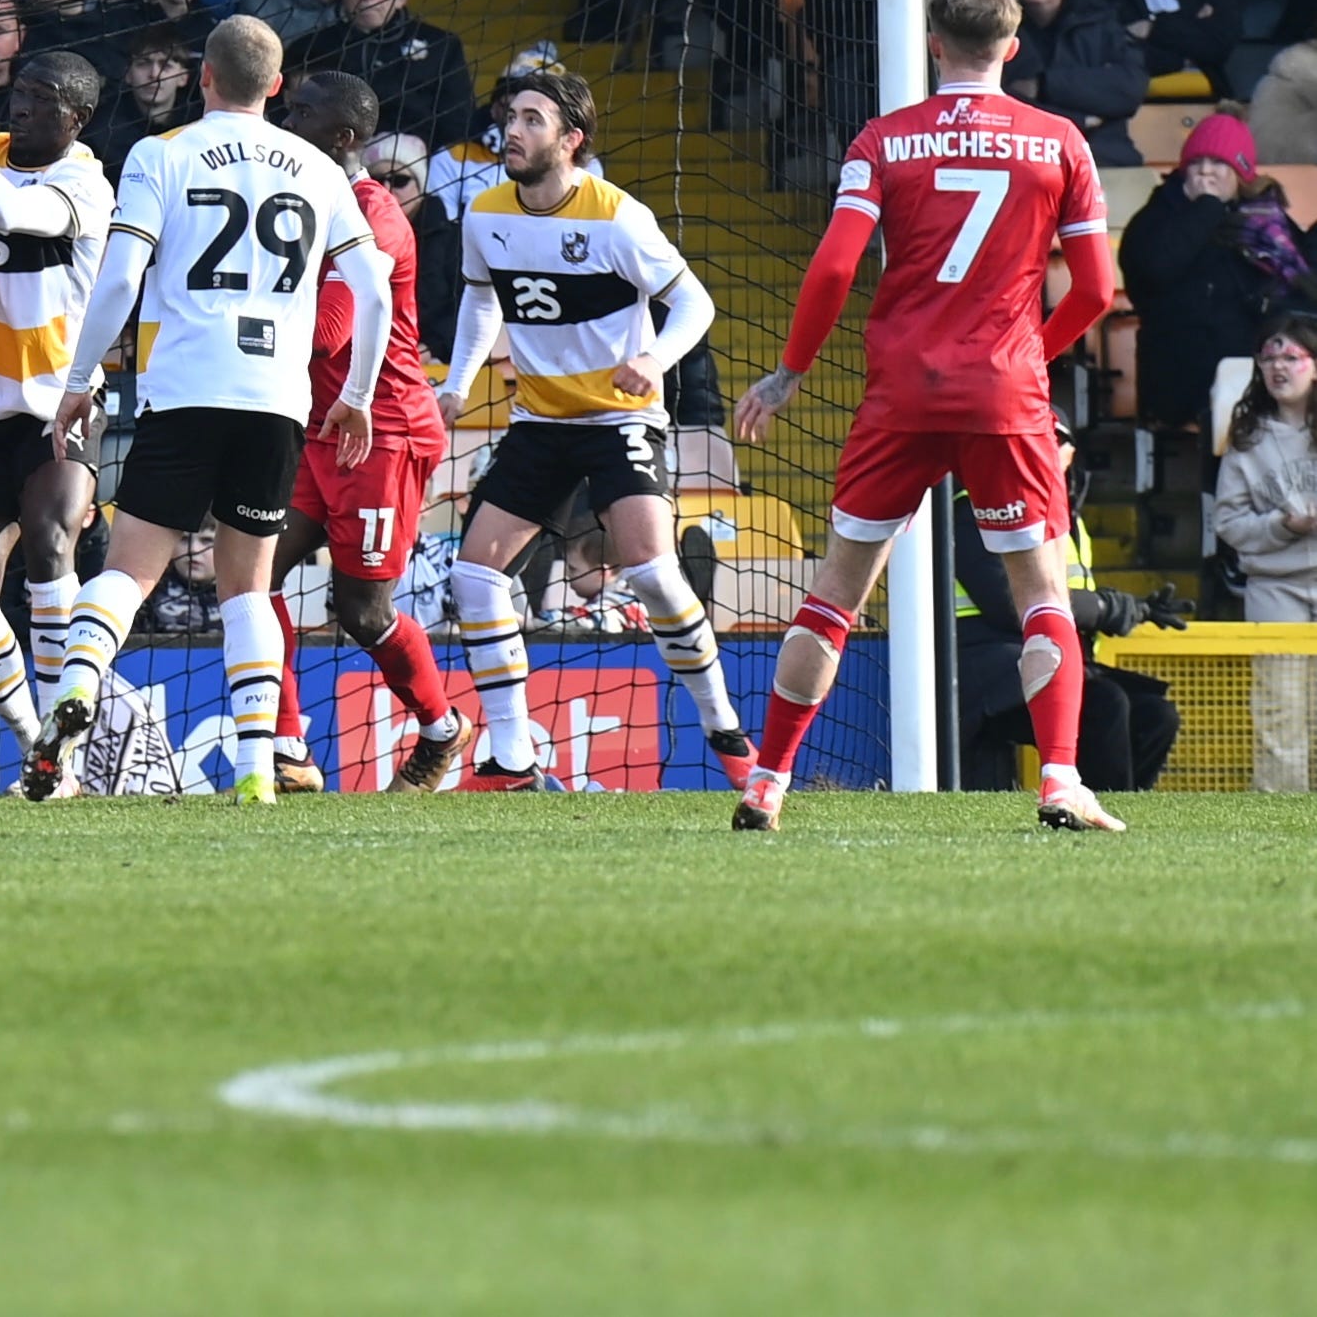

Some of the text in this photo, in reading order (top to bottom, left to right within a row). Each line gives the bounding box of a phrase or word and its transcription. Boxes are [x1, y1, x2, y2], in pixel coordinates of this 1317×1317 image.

[200, 141, 303, 178] WILSON
[883, 130, 1062, 166] WINCHESTER
[187, 188, 316, 294] 29
[934, 168, 1011, 283] 7
[619, 424, 654, 461] 3
[358, 507, 395, 552] 11
